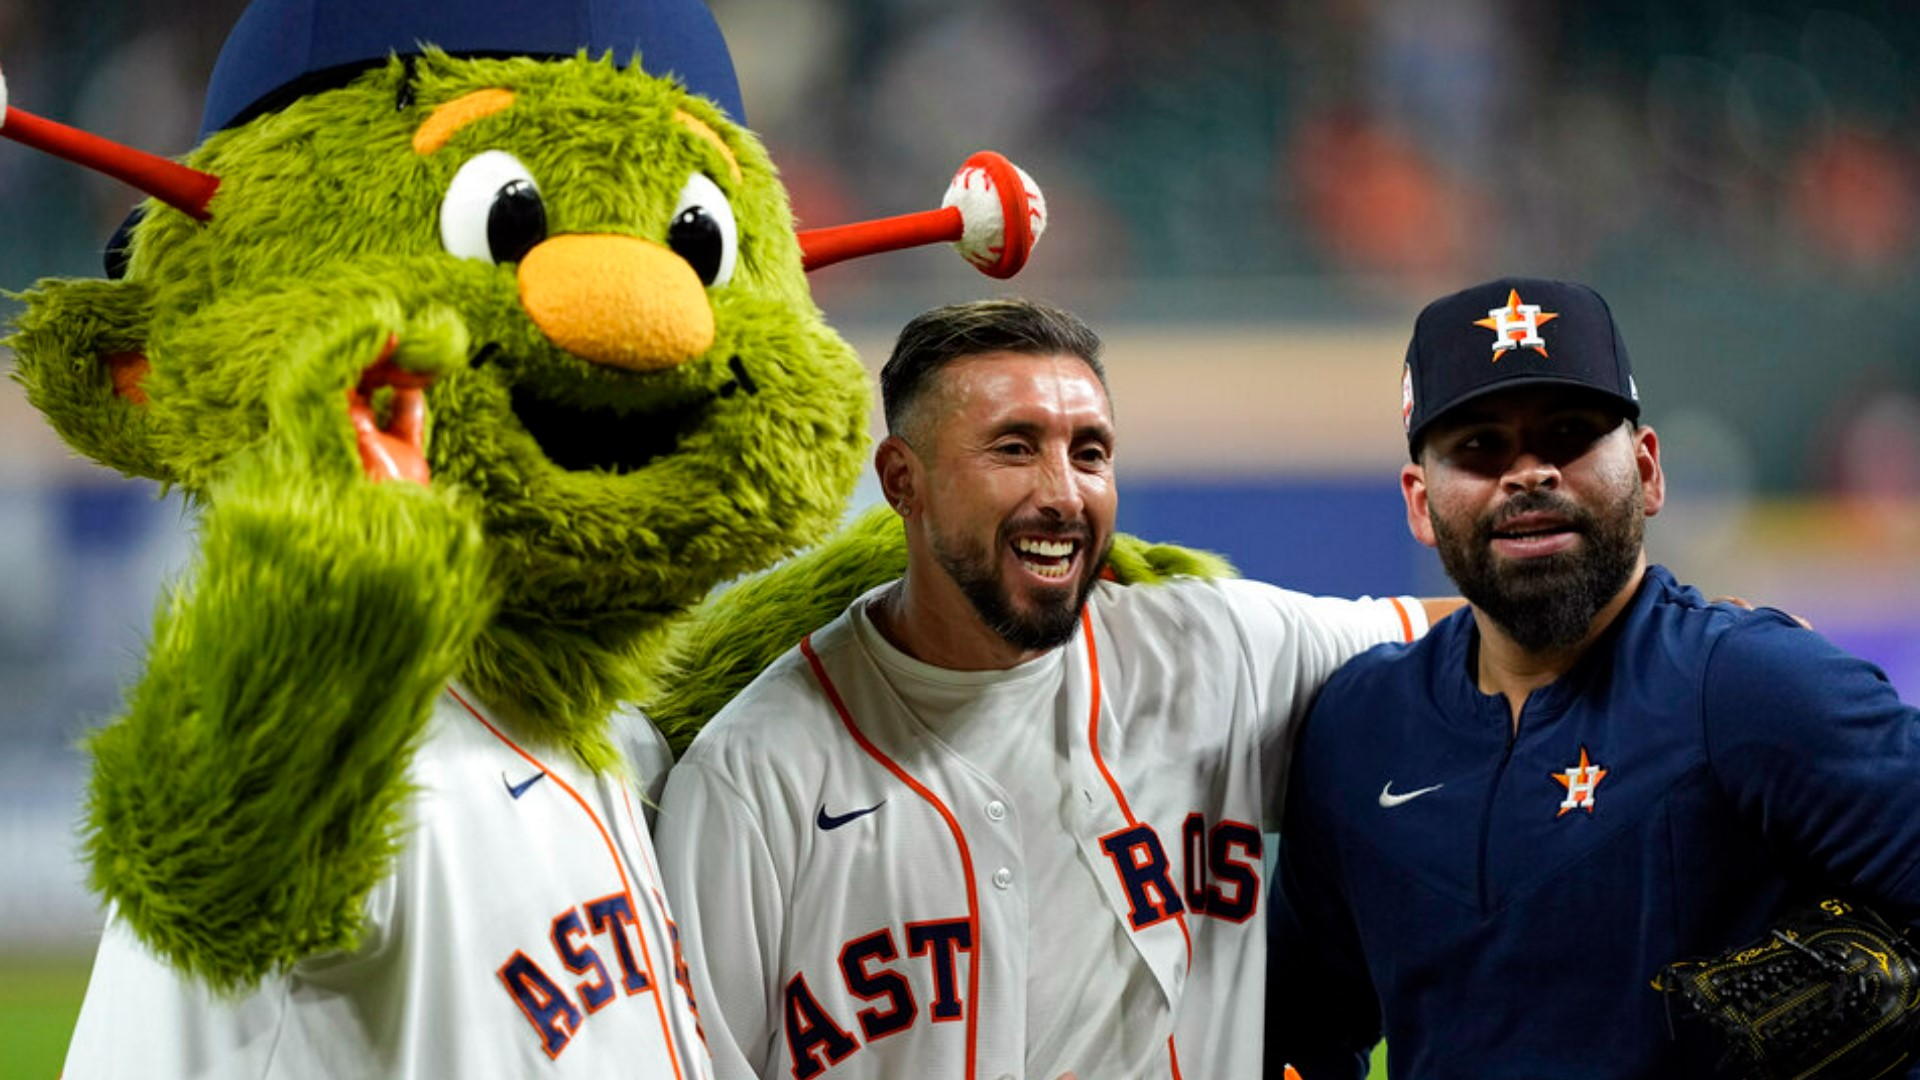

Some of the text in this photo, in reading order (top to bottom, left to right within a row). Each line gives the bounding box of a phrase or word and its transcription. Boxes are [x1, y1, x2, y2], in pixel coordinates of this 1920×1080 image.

[1488, 304, 1545, 351] H
[1560, 764, 1600, 808] H
[496, 891, 655, 1061] AST
[784, 916, 974, 1080] AST
[1098, 812, 1263, 933] ROS
